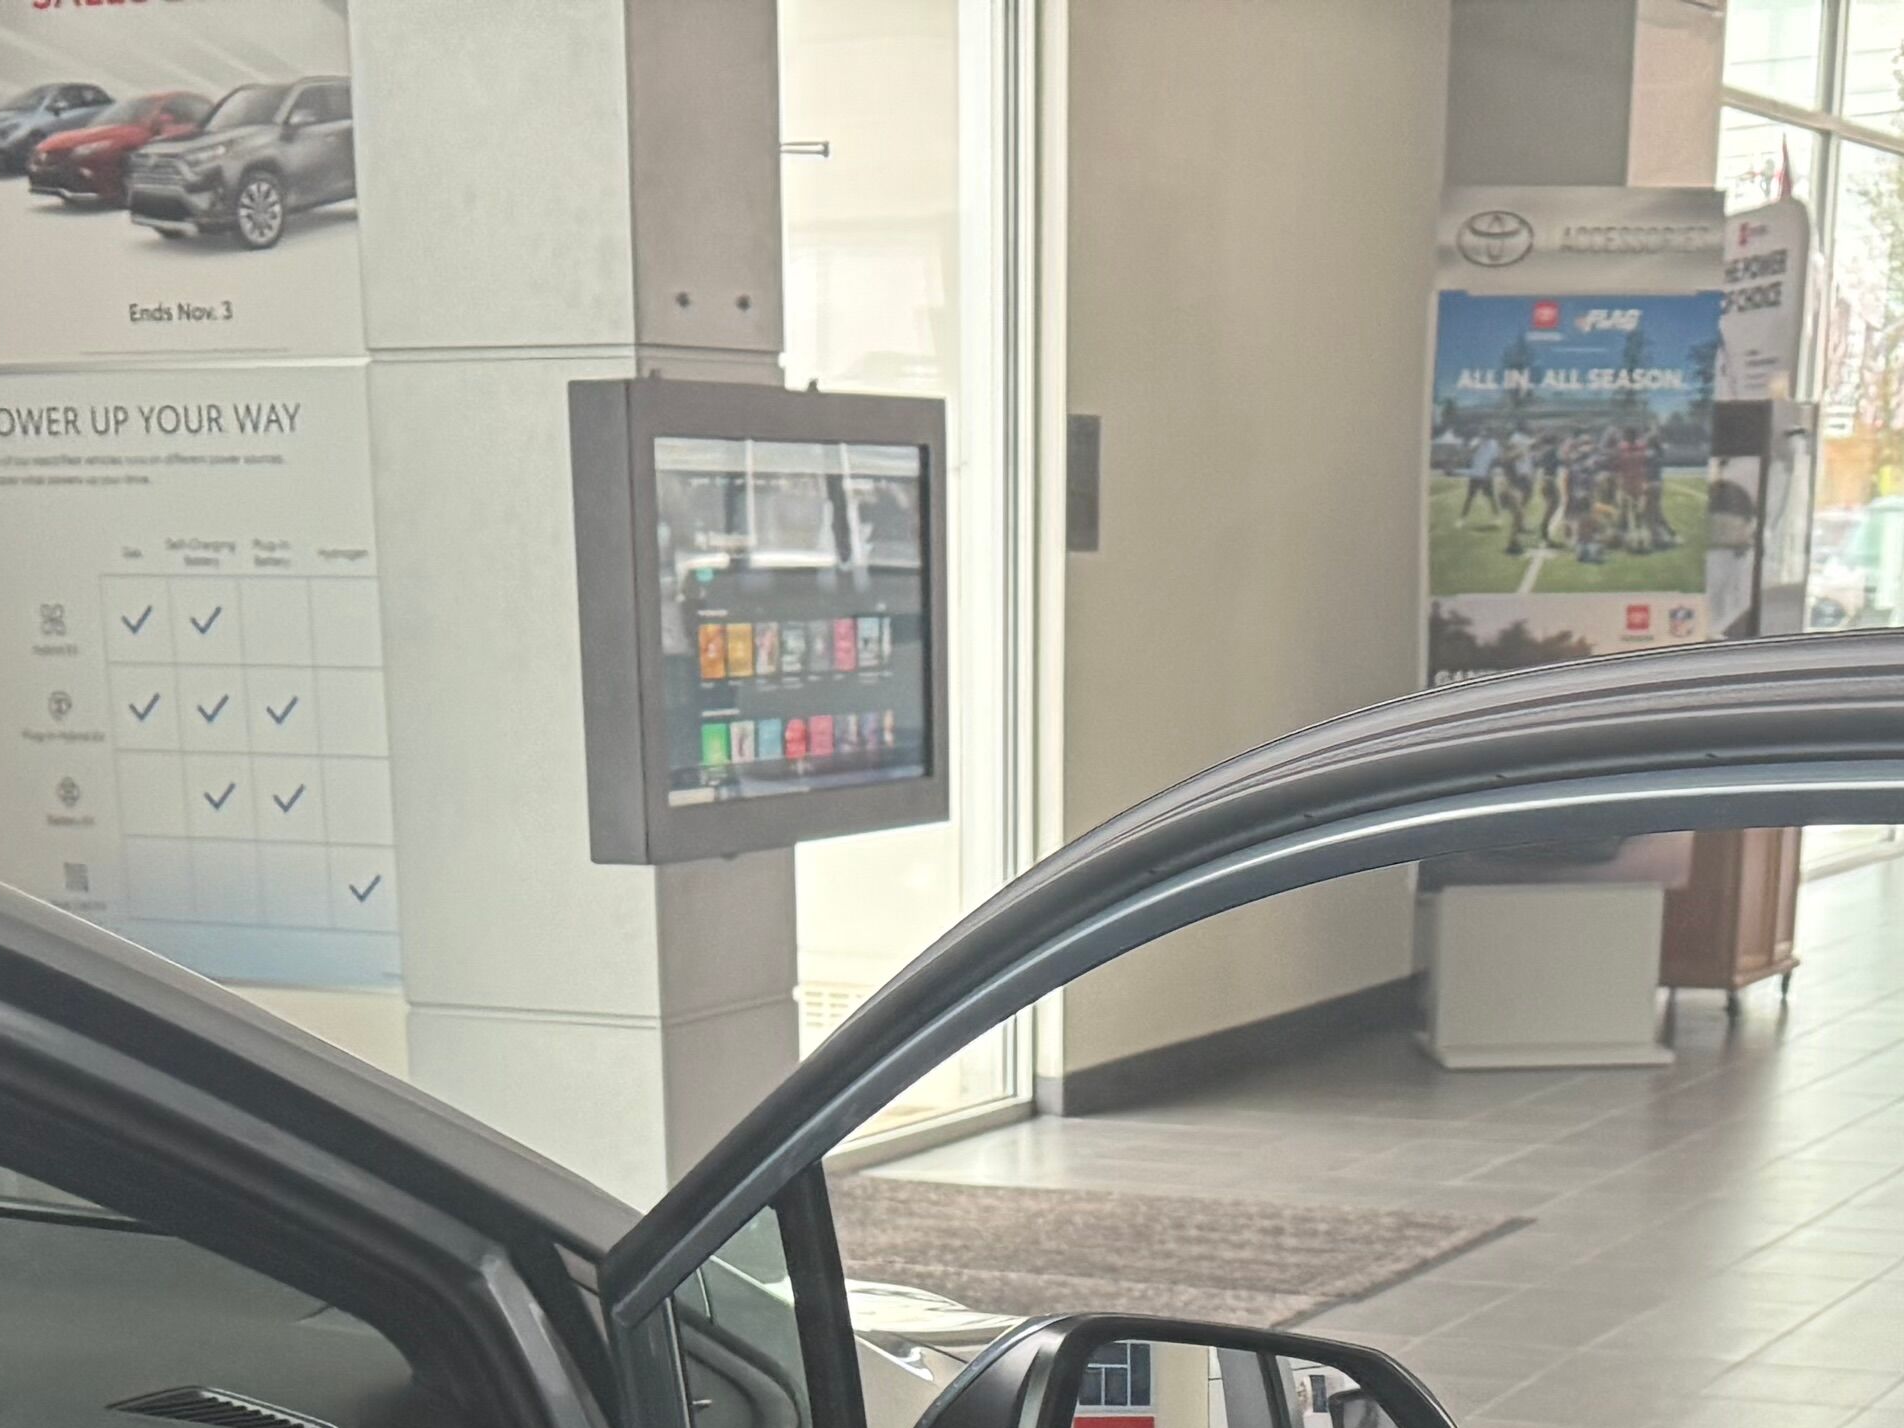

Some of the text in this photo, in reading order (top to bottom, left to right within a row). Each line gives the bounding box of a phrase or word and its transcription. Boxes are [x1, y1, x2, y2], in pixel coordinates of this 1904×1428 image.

[129, 300, 234, 321] Ends Nov. 3
[1456, 368, 1498, 390] ALL
[1543, 368, 1584, 389] ALL
[1587, 368, 1687, 389] SEASON.
[90, 405, 129, 436] UP
[137, 404, 223, 435] YOUR
[232, 402, 301, 434] WAY
